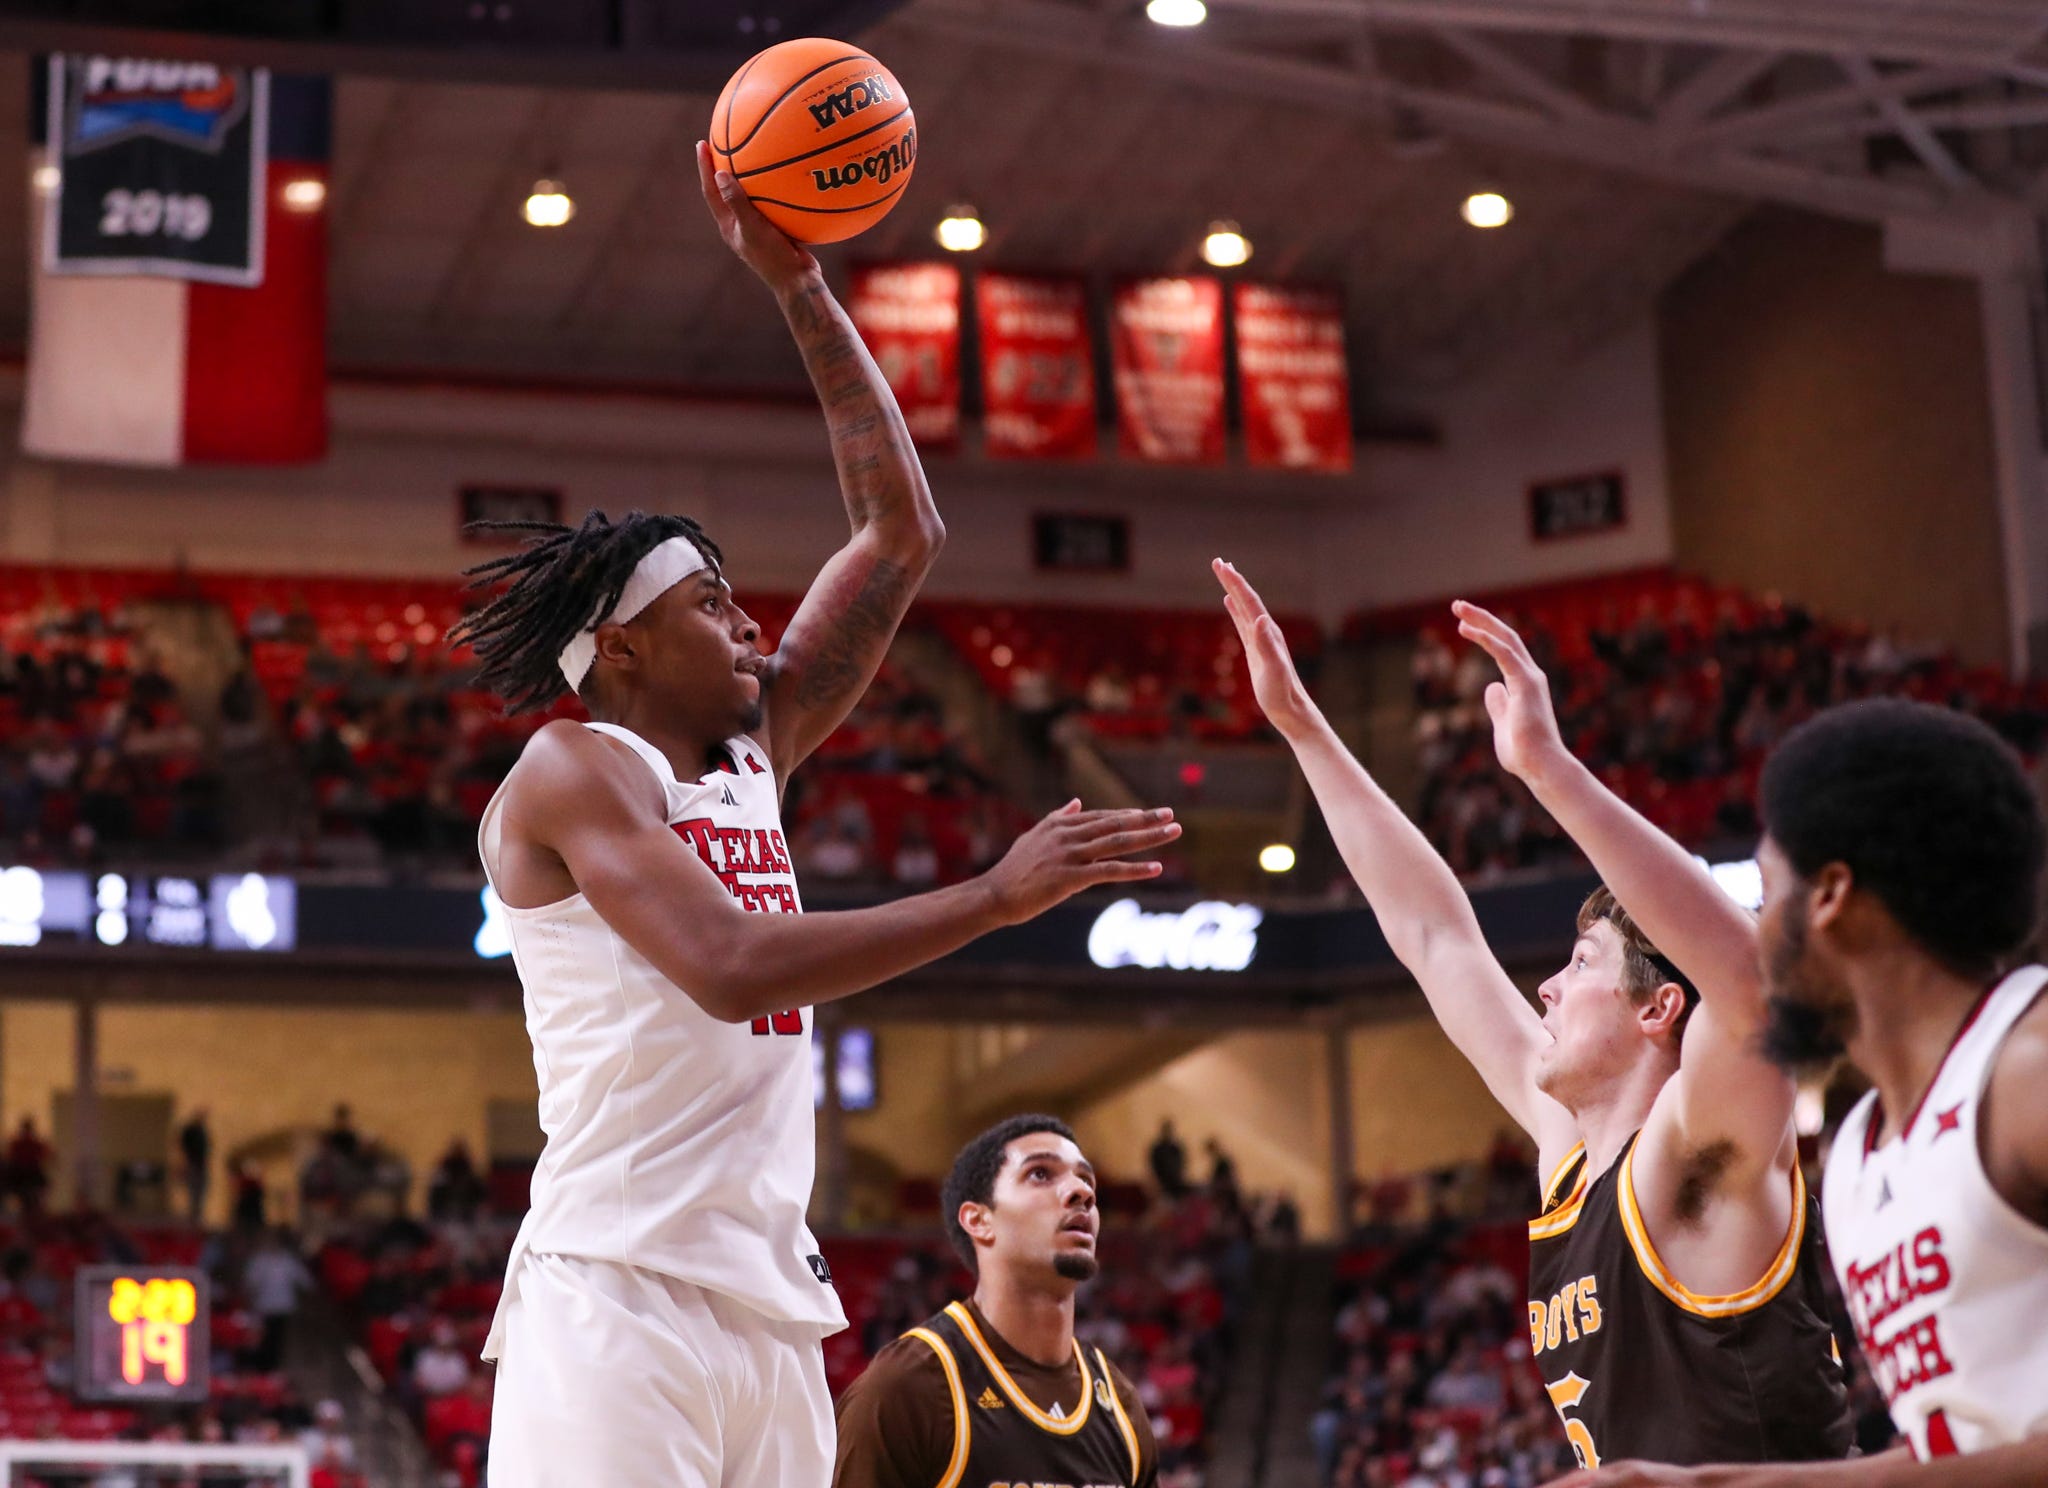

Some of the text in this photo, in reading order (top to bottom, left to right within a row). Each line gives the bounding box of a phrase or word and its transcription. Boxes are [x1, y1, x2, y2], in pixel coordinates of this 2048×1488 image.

[808, 74, 893, 130] NCAA
[812, 128, 917, 192] Wilson
[98, 188, 213, 241] 2019
[670, 818, 791, 875] TEXAS
[121, 1320, 188, 1386] 19
